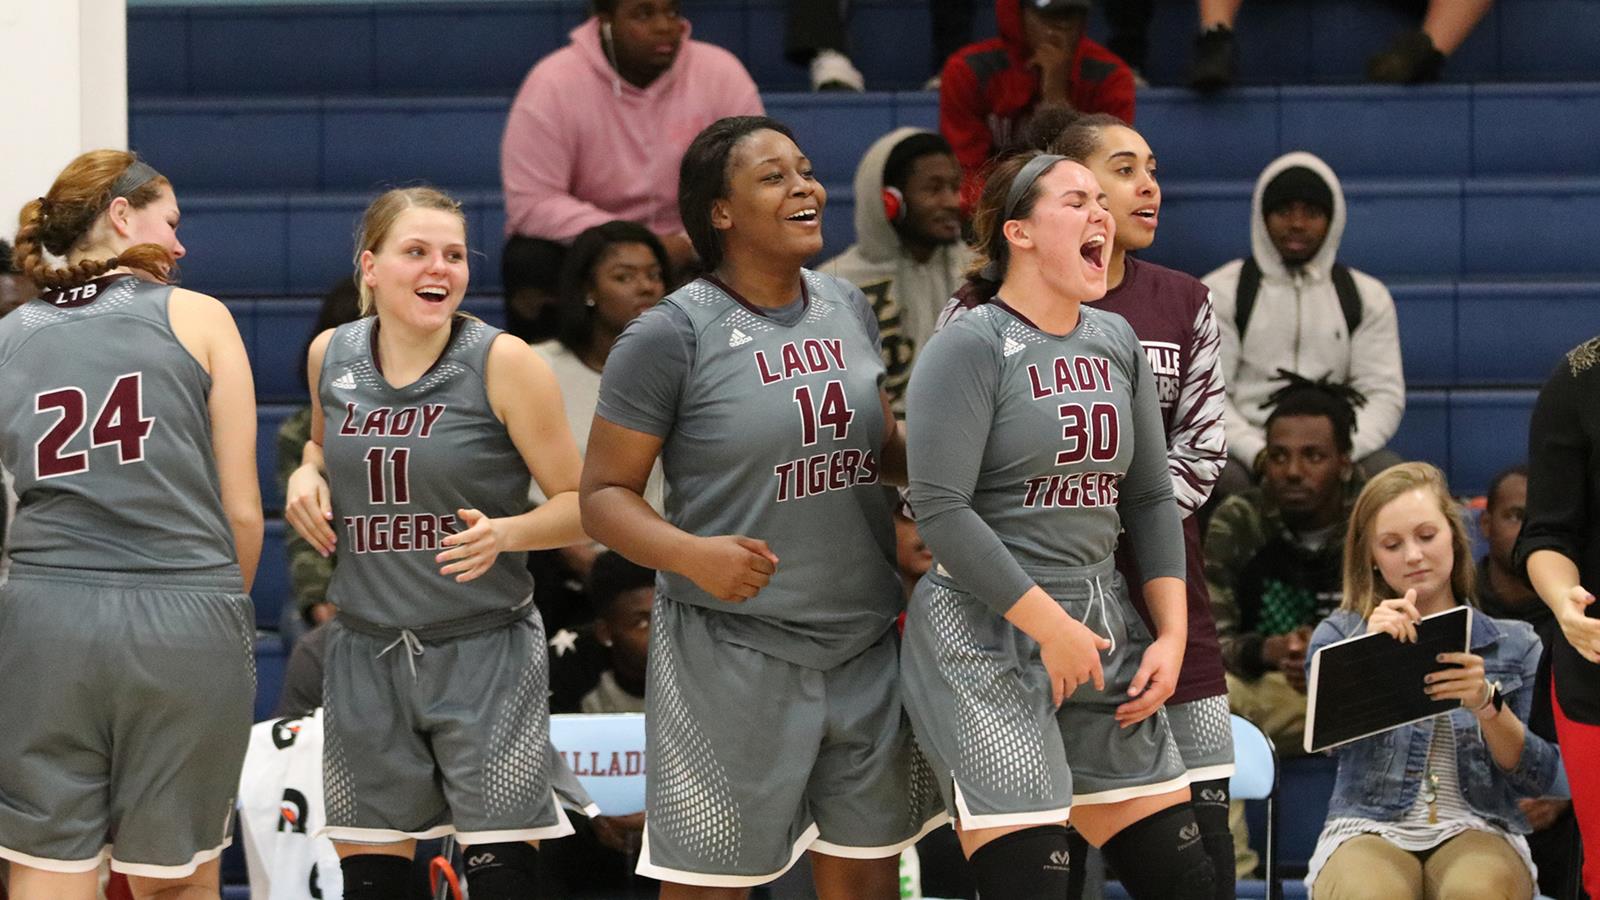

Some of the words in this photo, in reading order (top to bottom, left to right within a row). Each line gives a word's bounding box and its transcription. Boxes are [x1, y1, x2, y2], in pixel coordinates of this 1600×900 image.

[55, 283, 98, 305] LTB
[754, 338, 848, 386] LADY
[1026, 355, 1113, 400] LADY
[34, 371, 156, 480] 24
[339, 401, 447, 439] LADY
[793, 379, 855, 447] 14
[1055, 402, 1120, 466] 30
[364, 446, 410, 505] 11
[774, 448, 879, 502] TIGERS
[1023, 471, 1126, 508] TIGERS
[560, 751, 646, 776] LLAD
